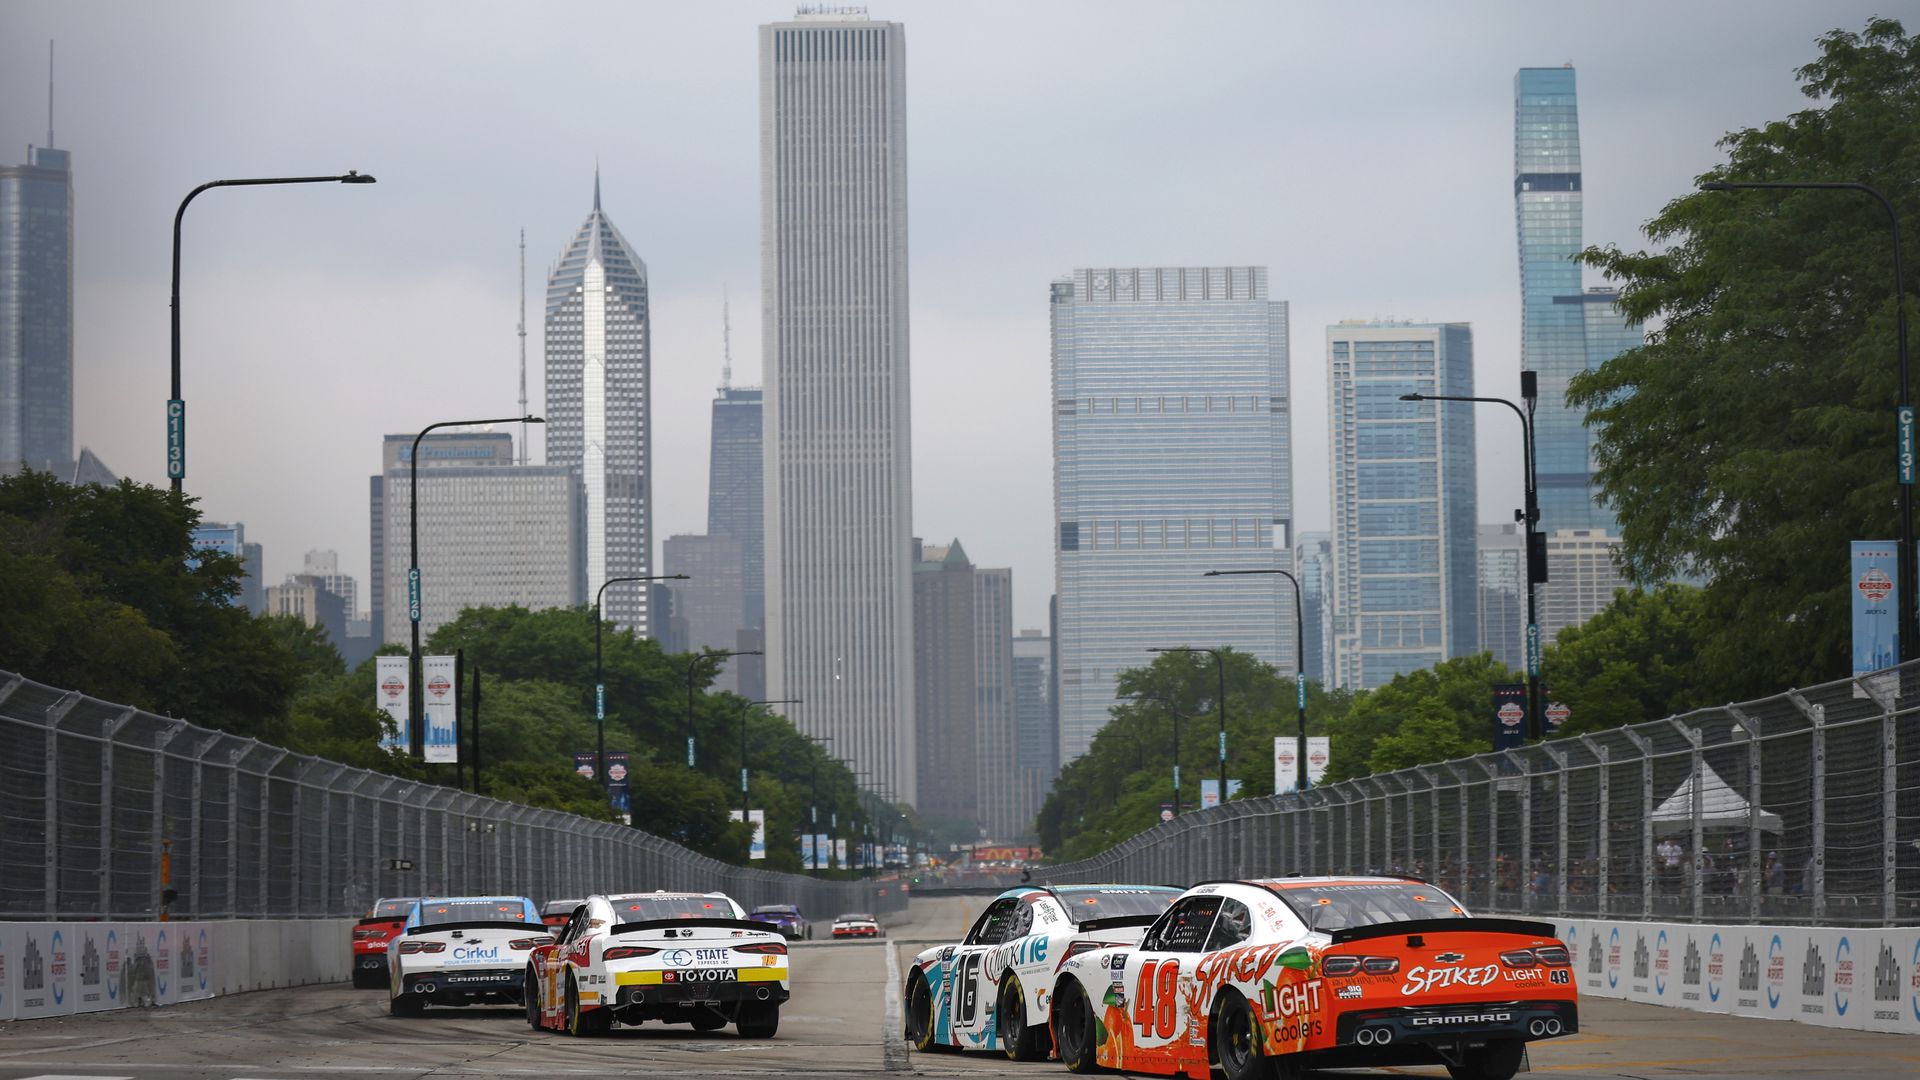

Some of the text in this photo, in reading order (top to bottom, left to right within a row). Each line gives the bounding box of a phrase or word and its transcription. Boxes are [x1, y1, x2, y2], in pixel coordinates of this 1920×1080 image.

[168, 402, 182, 475] C1130
[1899, 410, 1913, 481] C1131
[409, 570, 420, 619] C1120
[1527, 626, 1539, 675] C1121
[453, 946, 498, 960] Cirkul
[696, 949, 729, 960] STATE
[447, 975, 512, 983] CAMARO
[676, 968, 737, 982] TOYOTA
[954, 950, 986, 1028] 16
[1191, 940, 1294, 1016] SPIKED
[1401, 964, 1500, 997] SPIKED
[1503, 968, 1543, 981] LIGHT
[1514, 980, 1546, 988] coolers
[1549, 969, 1570, 985] 48
[1133, 958, 1180, 1040] 48
[1259, 978, 1322, 1022] LIGHT
[1273, 1019, 1323, 1044] coolers
[1412, 1012, 1512, 1026] CAMARO
